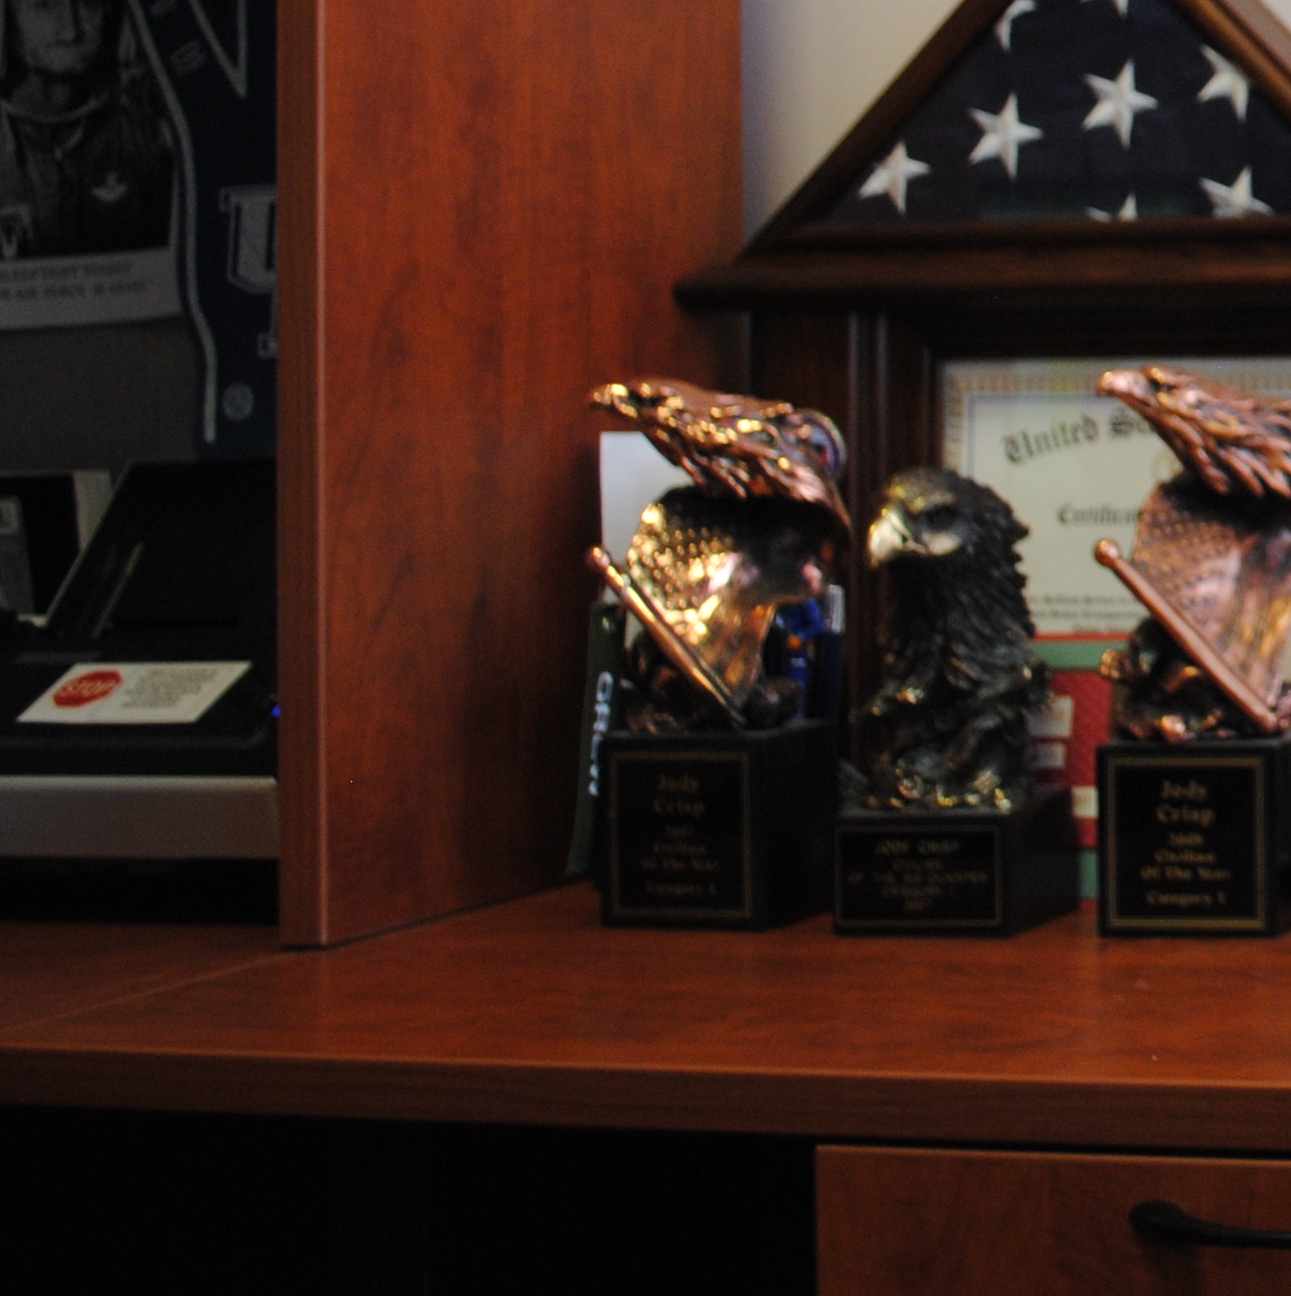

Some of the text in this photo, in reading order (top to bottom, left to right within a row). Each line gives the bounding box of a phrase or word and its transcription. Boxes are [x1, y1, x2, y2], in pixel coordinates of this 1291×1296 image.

[1004, 411, 1099, 465] United
[1160, 780, 1208, 803] Jody
[1156, 803, 1215, 827] Crisp
[1165, 865, 1193, 880] The
[1197, 865, 1231, 881] Year
